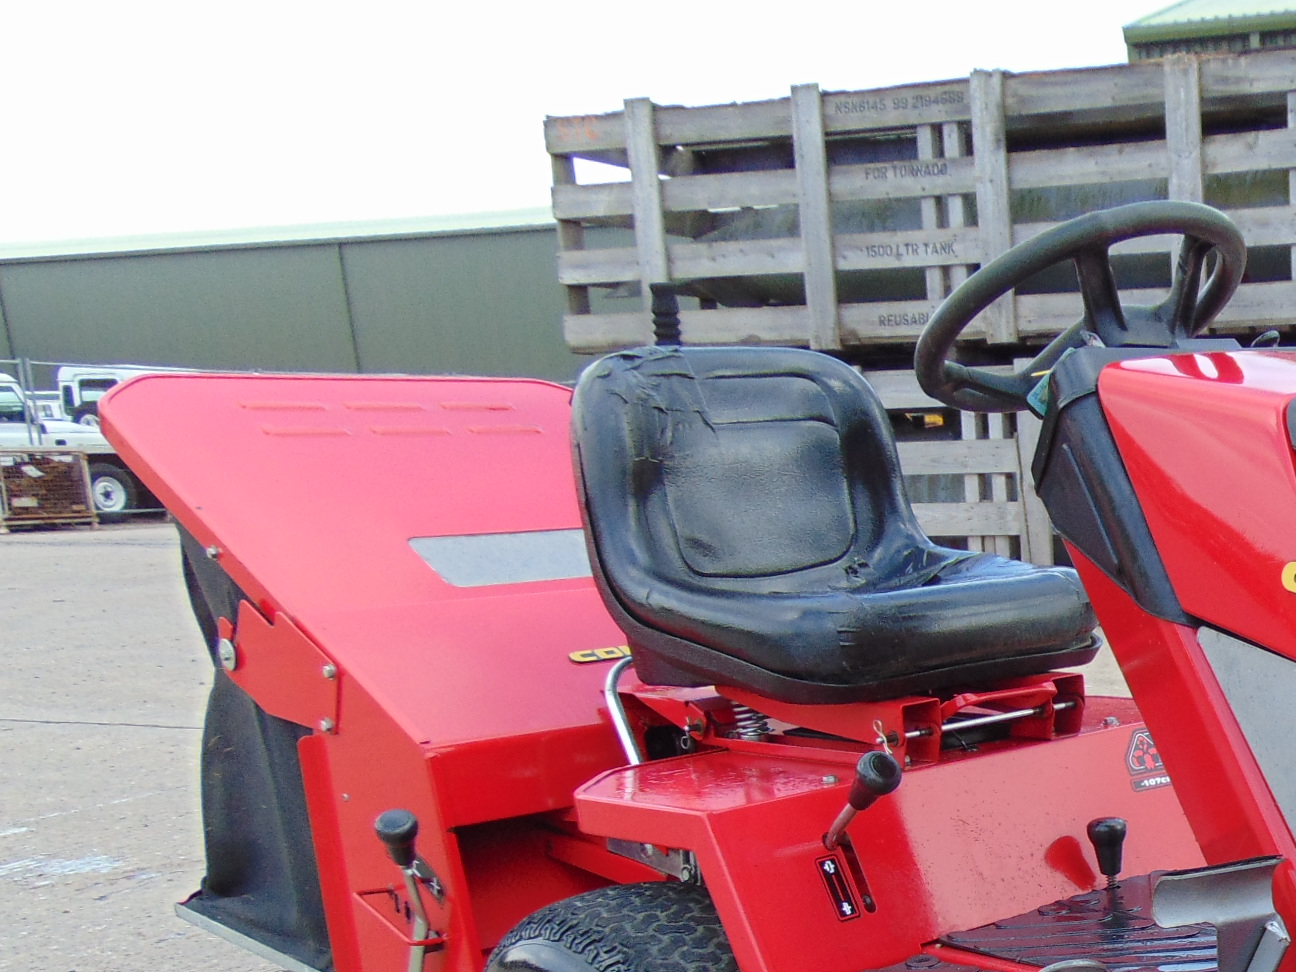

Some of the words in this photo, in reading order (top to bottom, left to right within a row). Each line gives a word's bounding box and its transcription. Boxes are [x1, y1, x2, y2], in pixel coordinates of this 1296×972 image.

[864, 166, 888, 180] FOR
[892, 162, 948, 178] TORNADO
[866, 244, 893, 258] 1500
[896, 243, 919, 257] LTR
[923, 241, 956, 256] TANK
